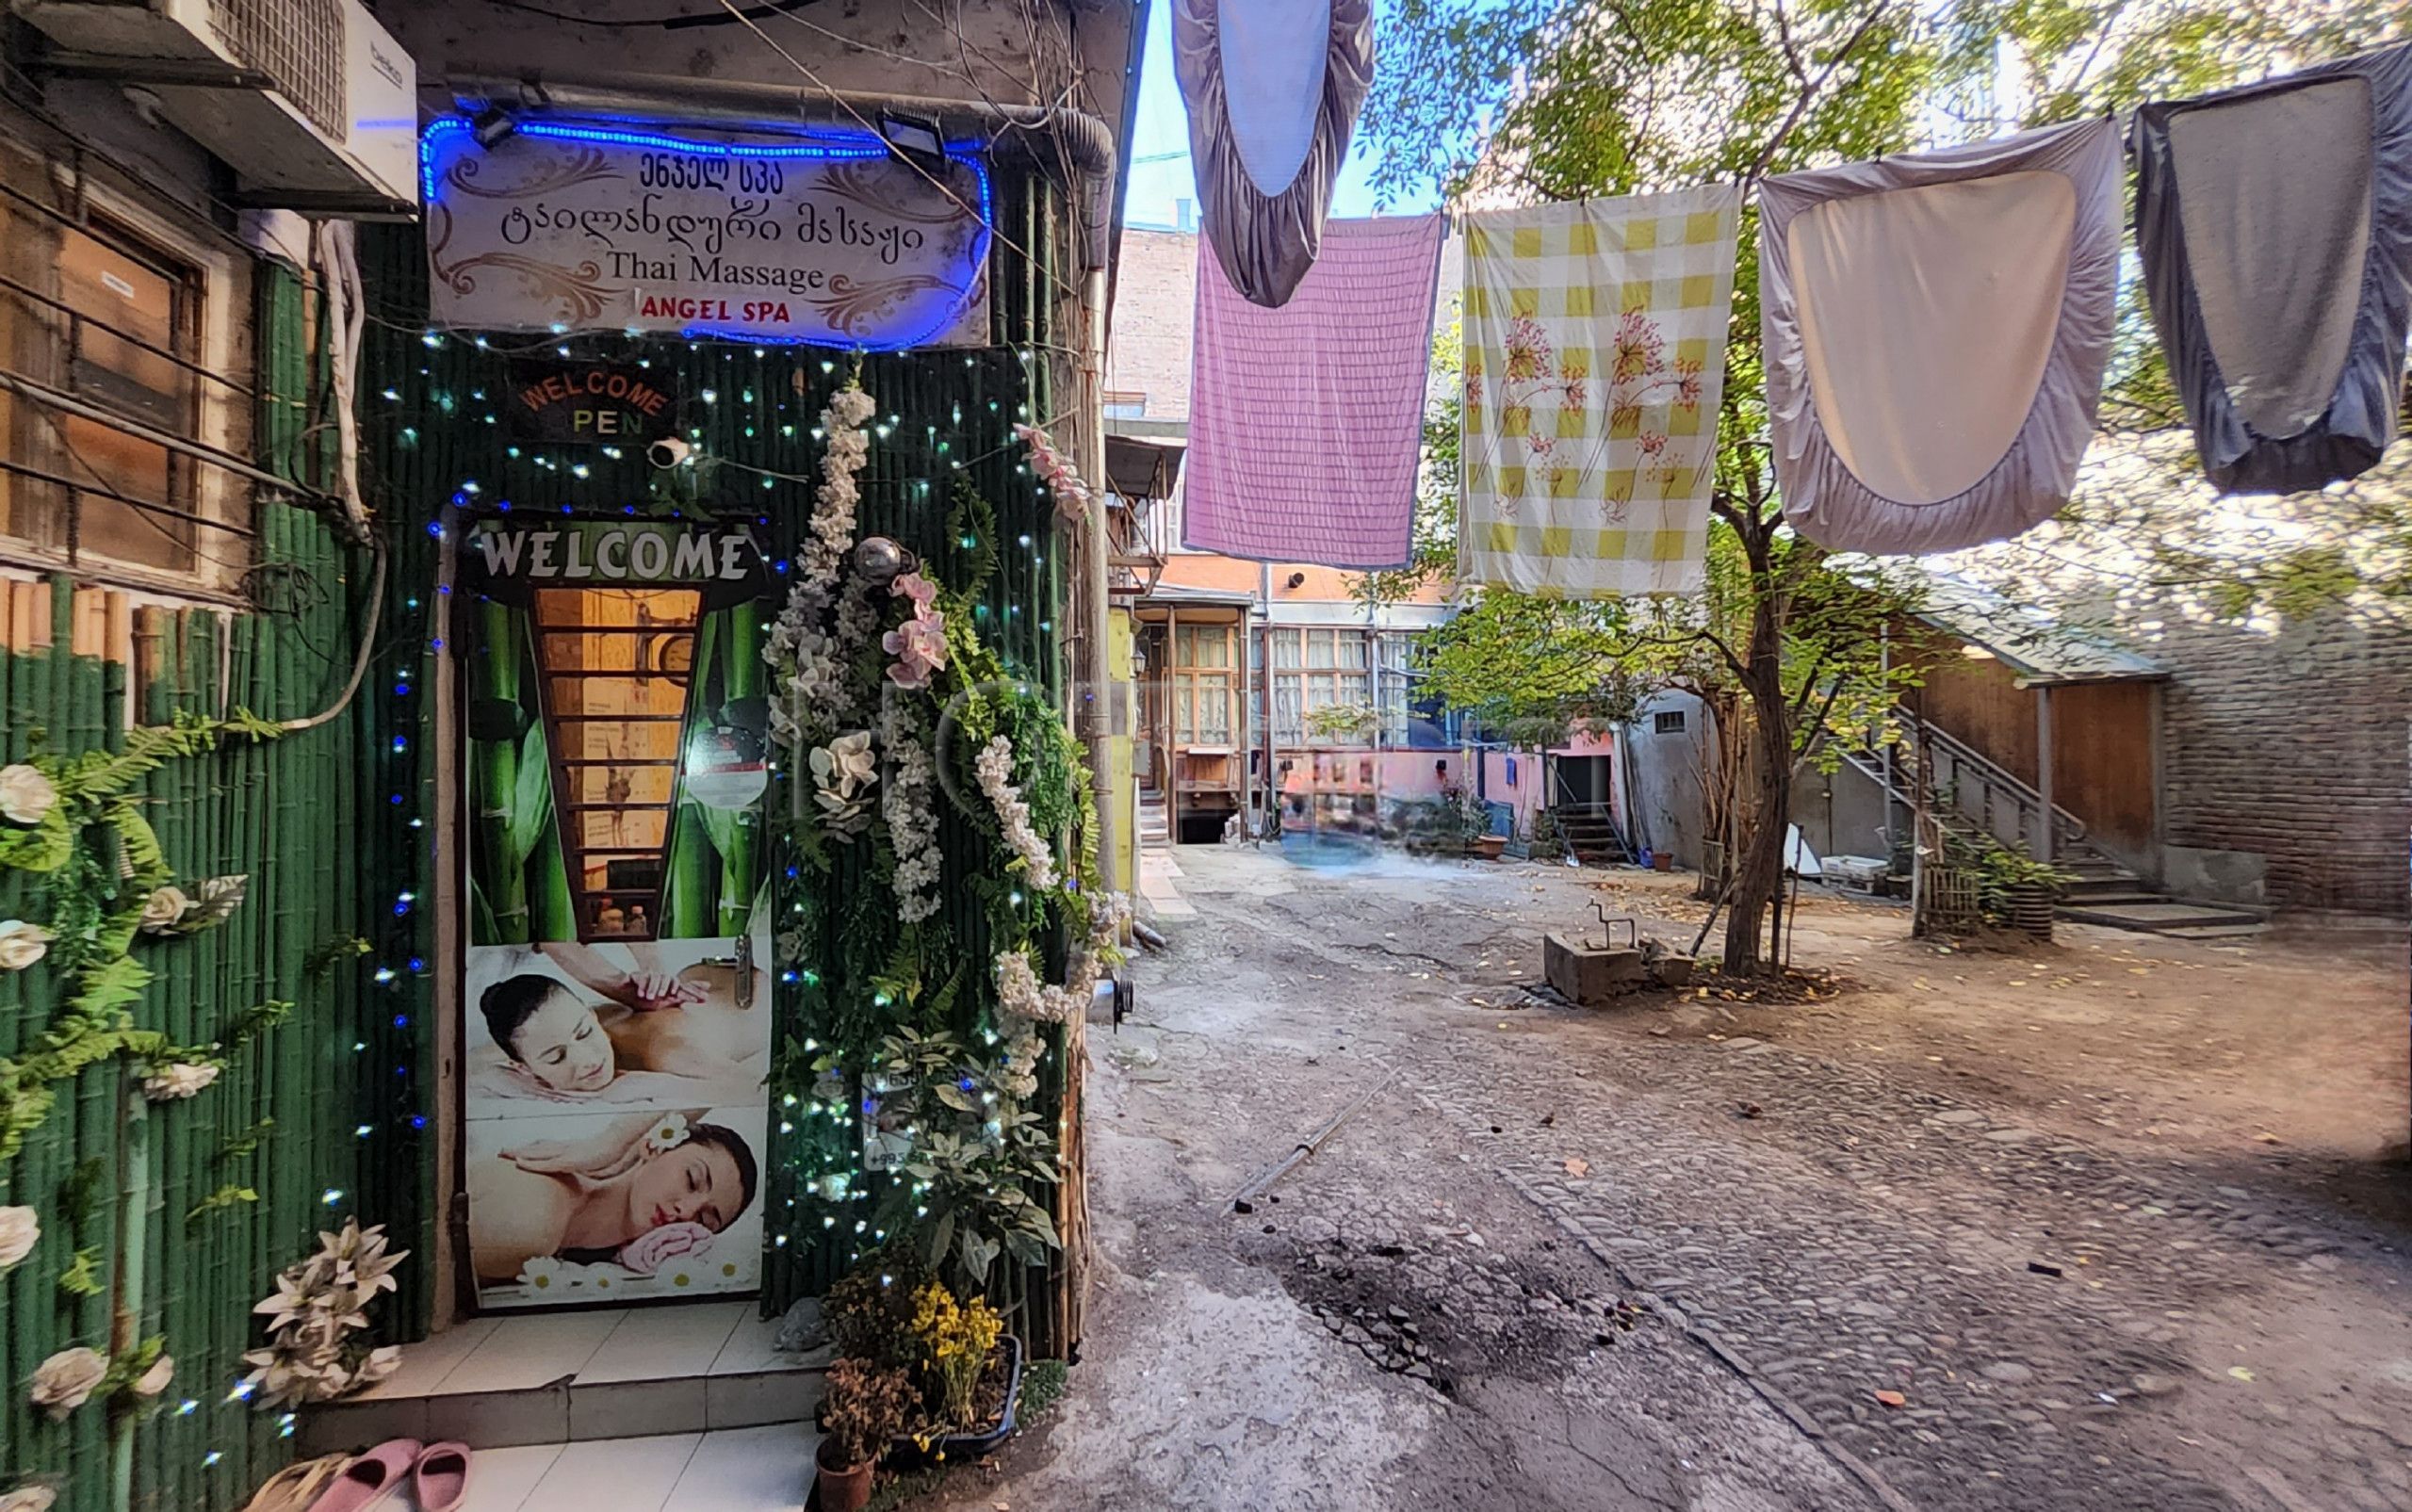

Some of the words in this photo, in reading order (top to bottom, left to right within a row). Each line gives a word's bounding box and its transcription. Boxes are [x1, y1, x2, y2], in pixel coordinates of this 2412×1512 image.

[640, 153, 729, 191] ენჯელ
[740, 159, 784, 194] სპა
[501, 193, 781, 254] ტაილანდური
[797, 203, 923, 265] მასაჟი
[607, 252, 677, 282] Thai
[689, 255, 823, 295] Massage
[641, 296, 731, 320] ANGEL
[742, 301, 790, 323] SPA
[520, 371, 669, 415] WELCOME
[481, 530, 749, 580] WELCOME
